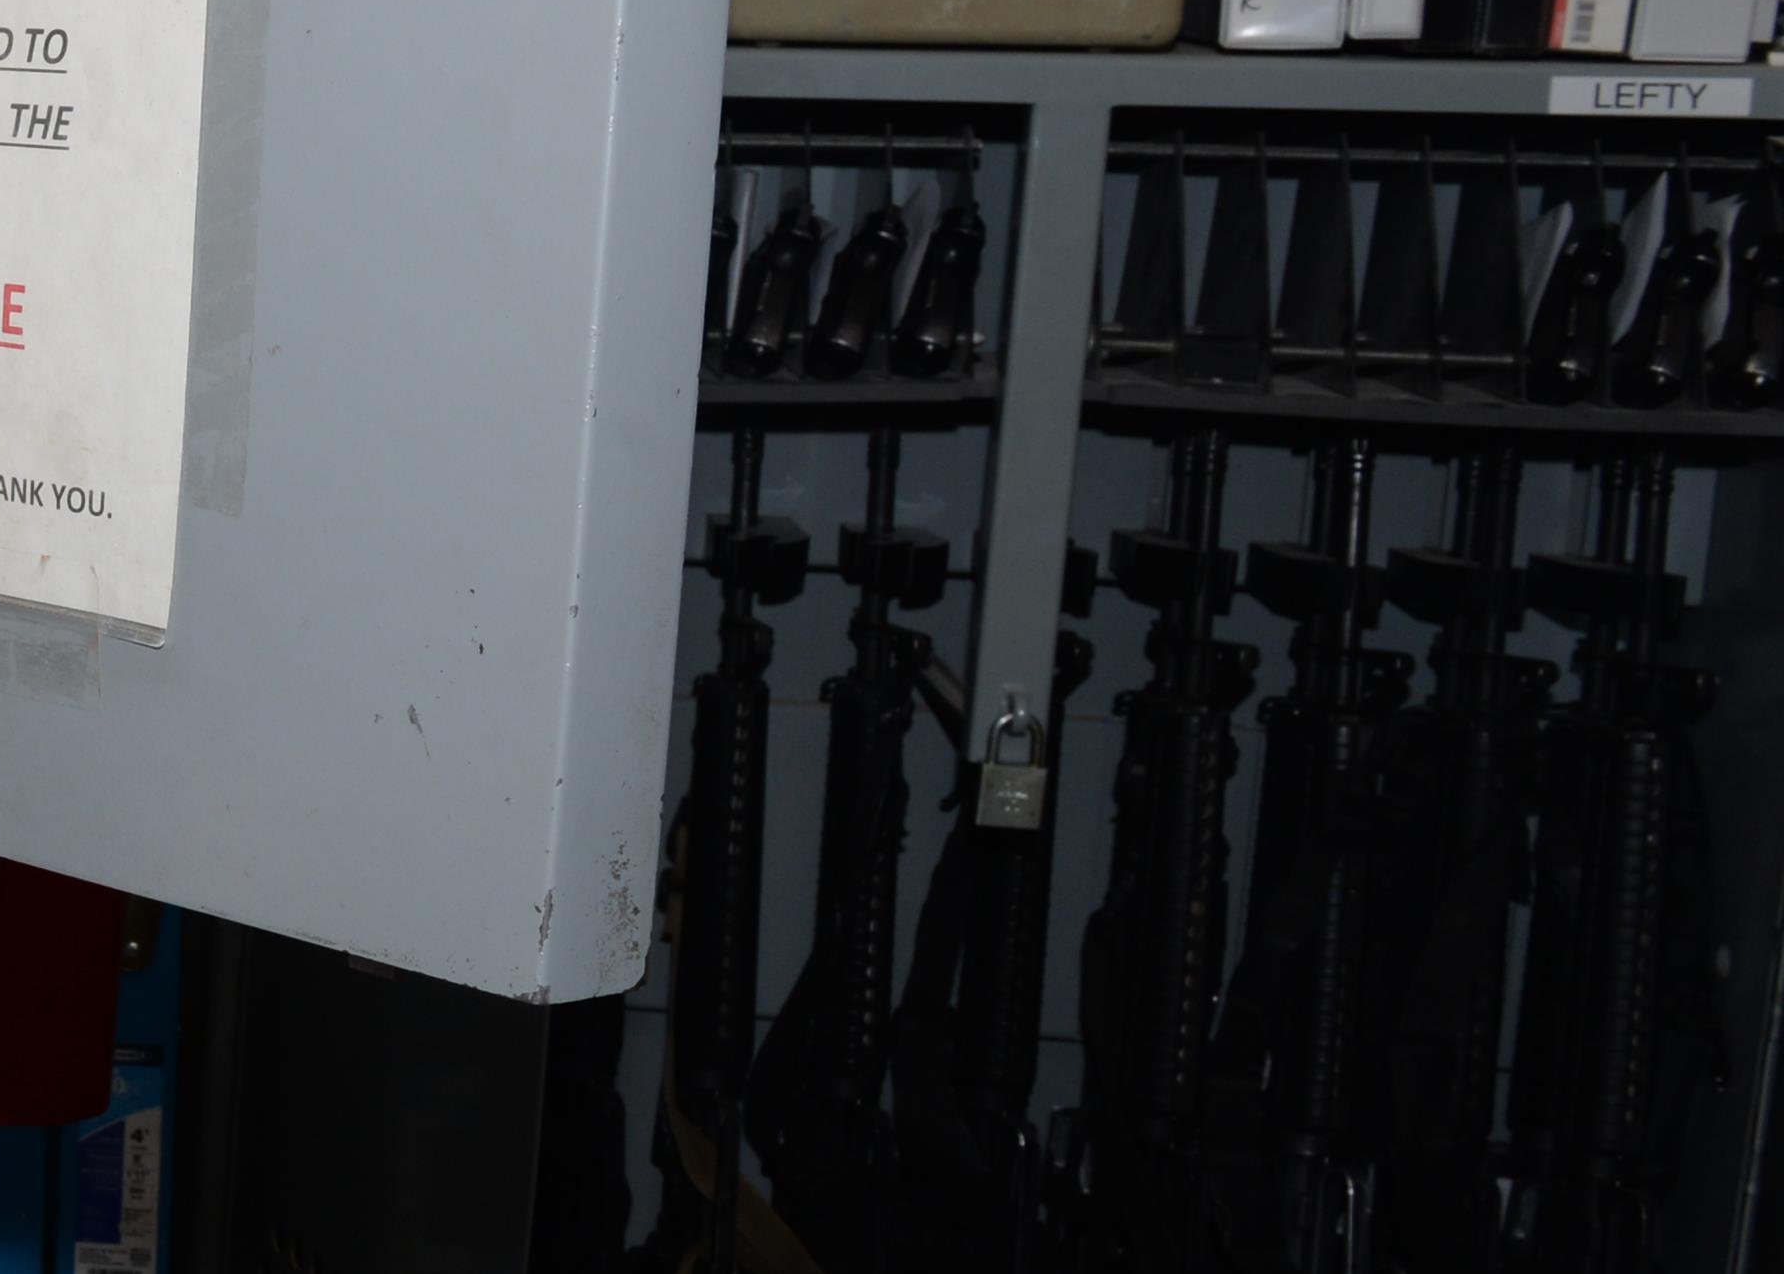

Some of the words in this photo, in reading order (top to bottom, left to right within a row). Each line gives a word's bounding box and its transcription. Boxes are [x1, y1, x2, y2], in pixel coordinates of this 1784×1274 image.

[26, 29, 67, 63] TO
[1593, 82, 1708, 112] LEFTY
[11, 104, 73, 140] THE
[52, 484, 111, 518] YOU.
